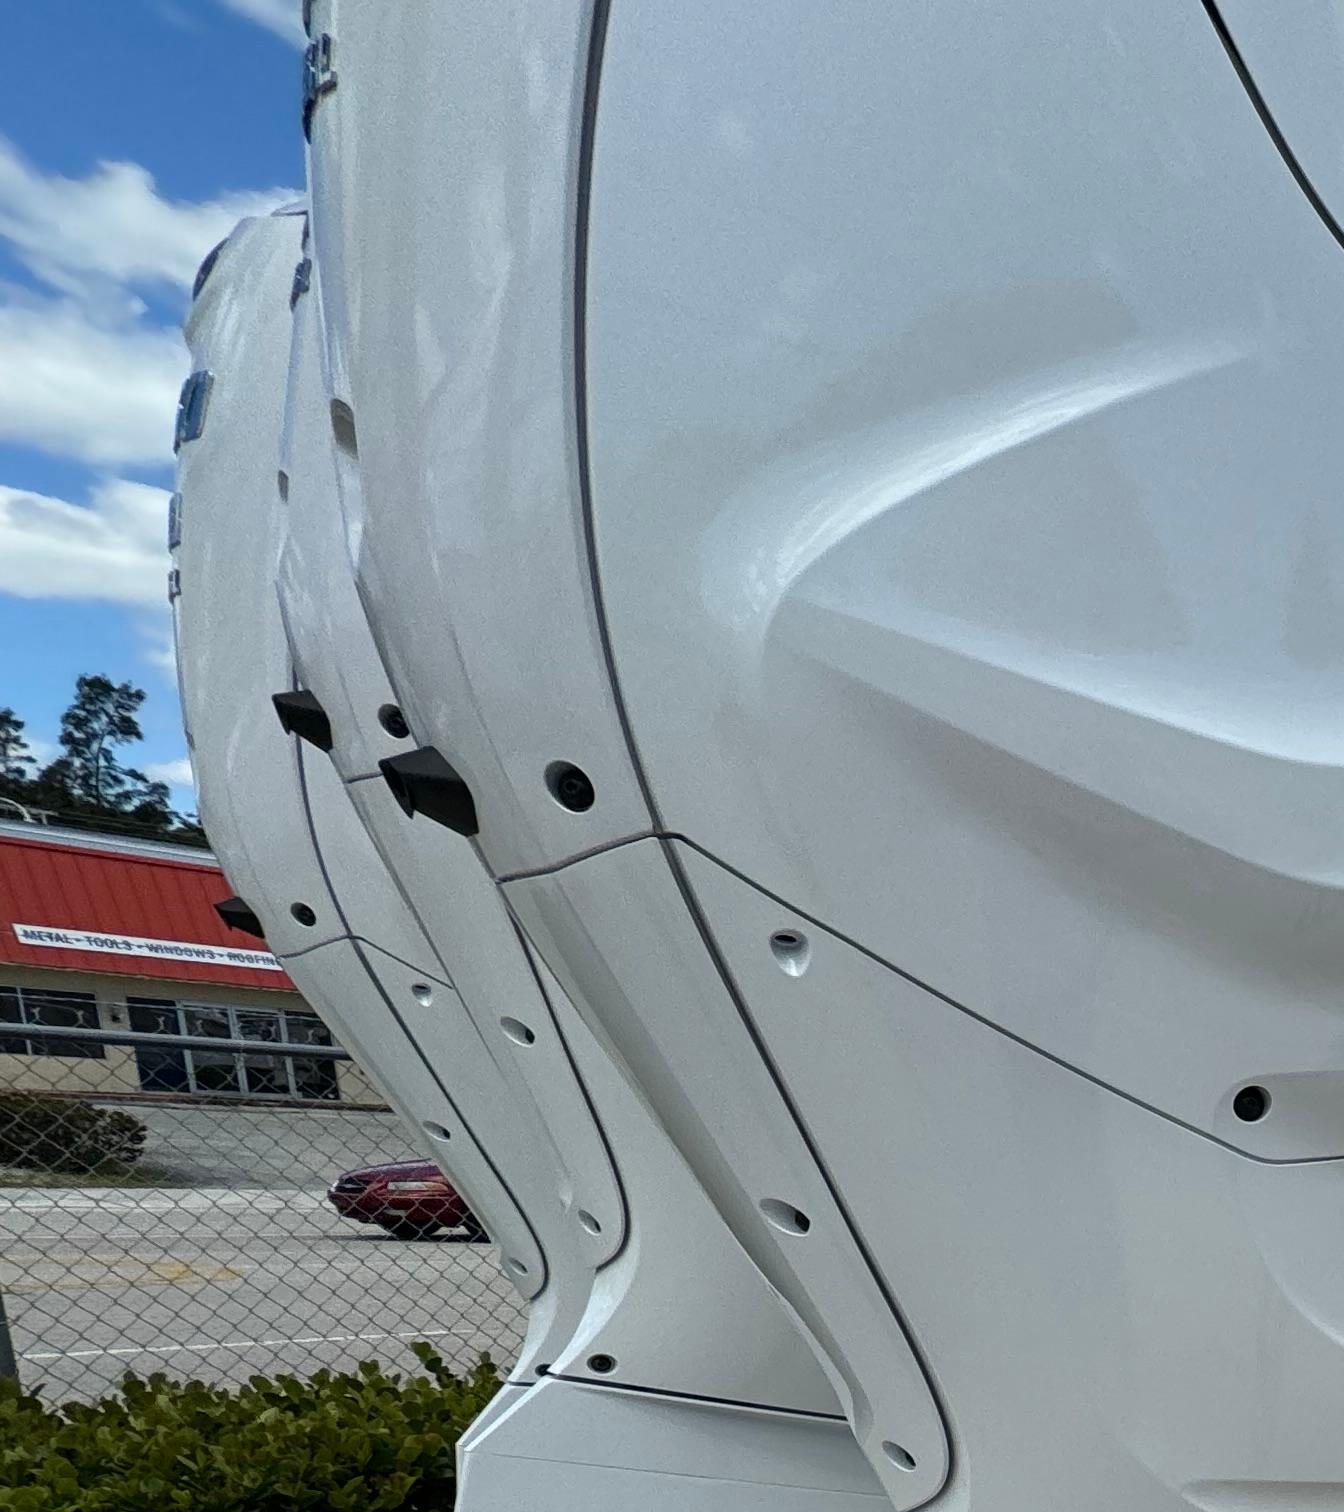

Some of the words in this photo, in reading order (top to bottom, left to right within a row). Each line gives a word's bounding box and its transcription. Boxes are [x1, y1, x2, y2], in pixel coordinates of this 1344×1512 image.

[21, 928, 73, 945] METAL
[84, 935, 133, 951] TOOLS
[146, 942, 216, 960] WINDOWS
